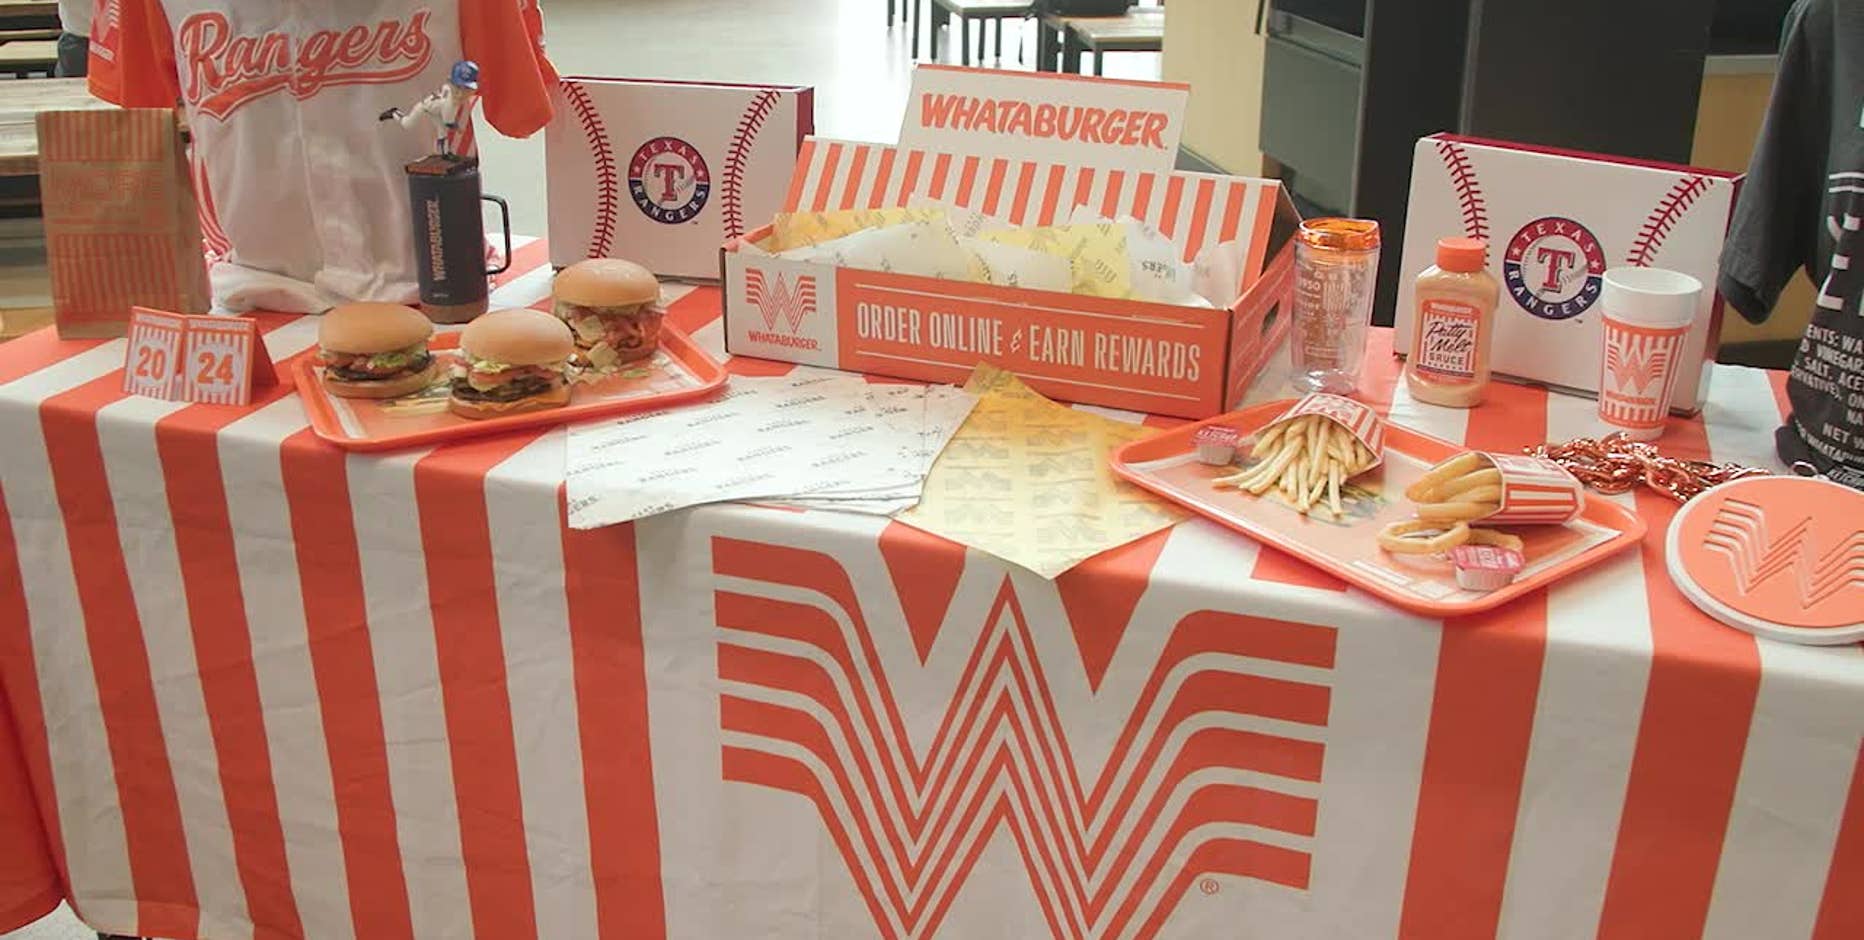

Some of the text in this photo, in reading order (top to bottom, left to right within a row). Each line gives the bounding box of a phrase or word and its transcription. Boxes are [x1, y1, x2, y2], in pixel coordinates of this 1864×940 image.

[179, 11, 431, 105] Rangers
[921, 92, 1168, 150] WHATABURGER
[639, 140, 699, 166] TEXAS
[632, 185, 706, 221] RANGERS
[1521, 222, 1596, 253] TEXAS
[1537, 246, 1576, 293] T
[1508, 269, 1598, 316] RANGERS
[747, 330, 819, 350] WHATABURGER
[857, 302, 1201, 382] ORDER ONLINE & EARN REWARDS
[135, 346, 166, 380] 20
[196, 352, 235, 385] 24
[1429, 352, 1465, 365] SAUCE
[1822, 422, 1851, 445] NET
